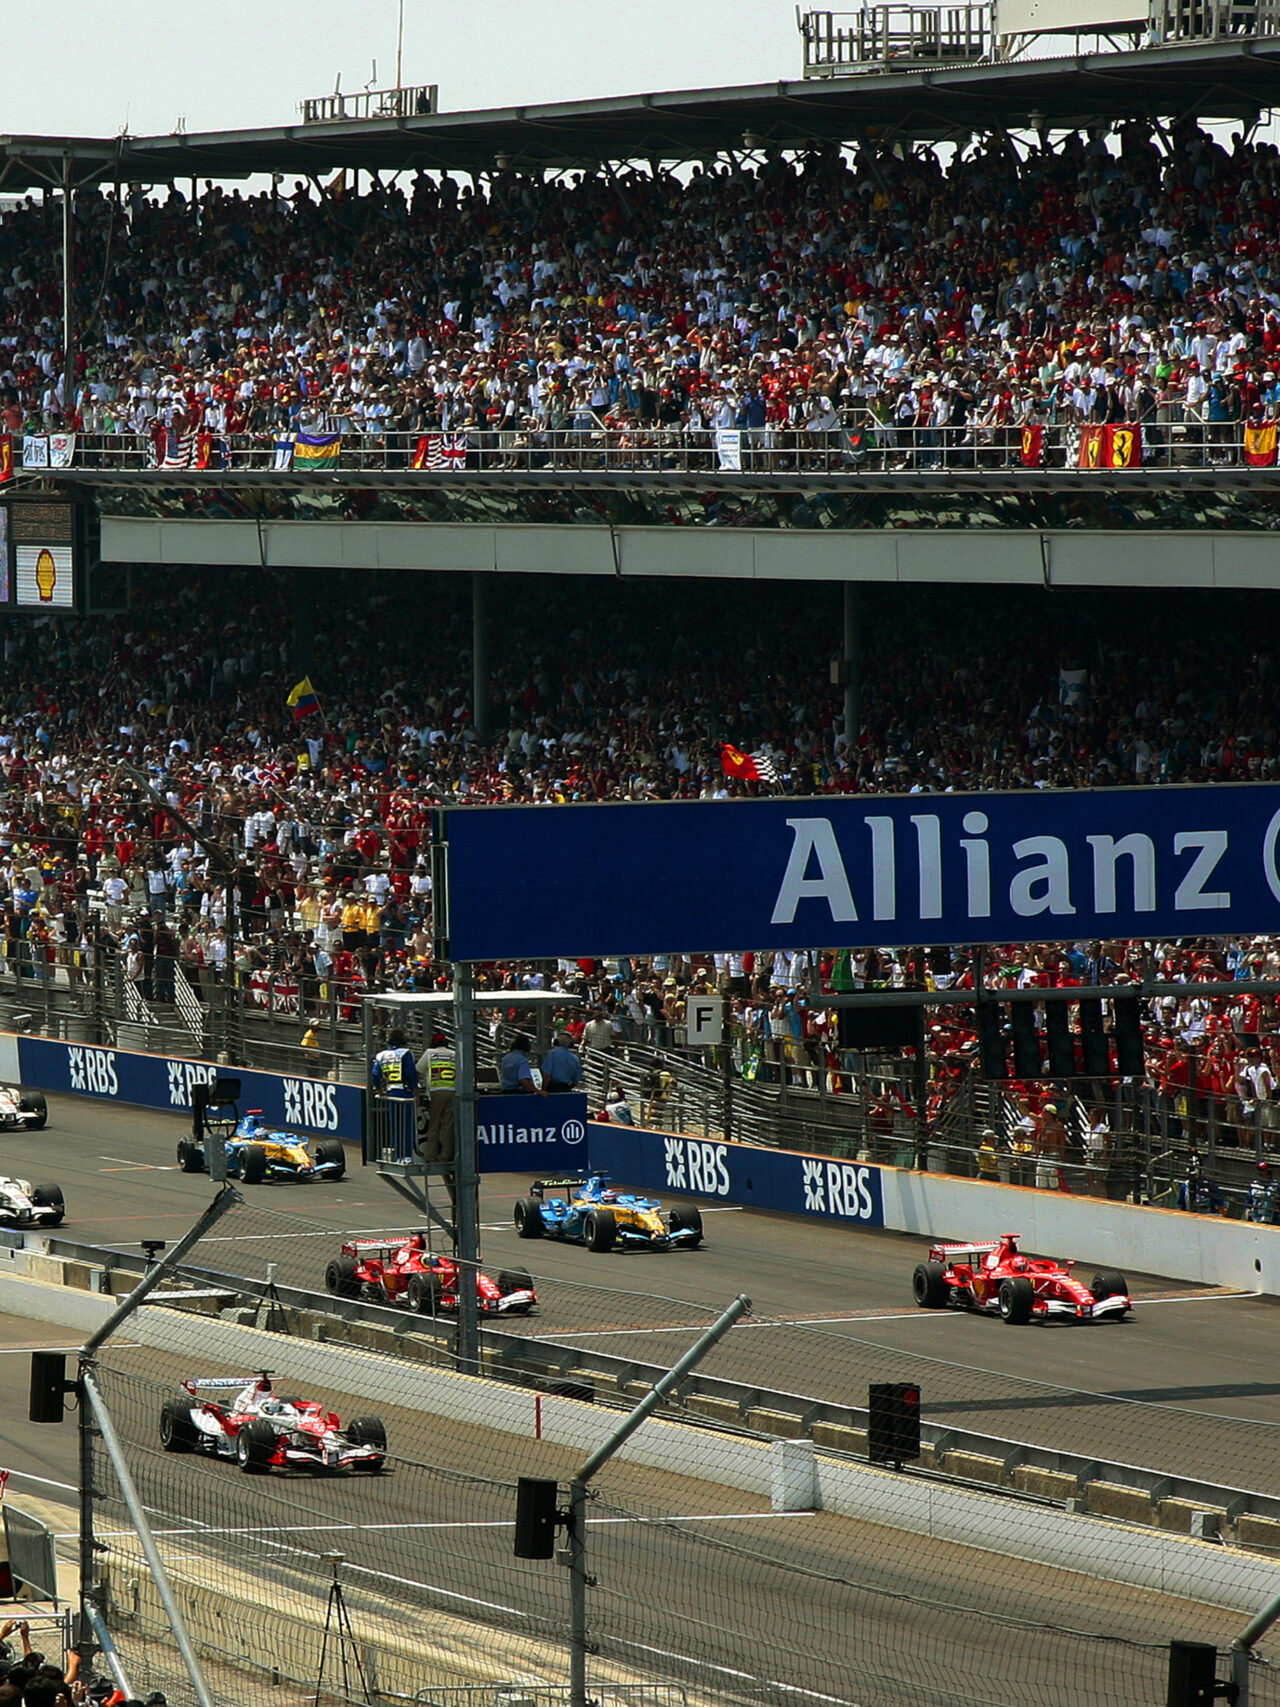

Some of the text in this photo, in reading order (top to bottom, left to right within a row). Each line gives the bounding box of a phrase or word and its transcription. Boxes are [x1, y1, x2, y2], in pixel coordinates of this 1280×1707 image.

[770, 811, 1231, 924] Allianz
[696, 1007, 713, 1032] F
[86, 1050, 119, 1096] RBS
[302, 1081, 339, 1131] RBS
[476, 1124, 557, 1145] Allianz
[686, 1141, 730, 1196] RBS
[826, 1162, 873, 1220] RBS
